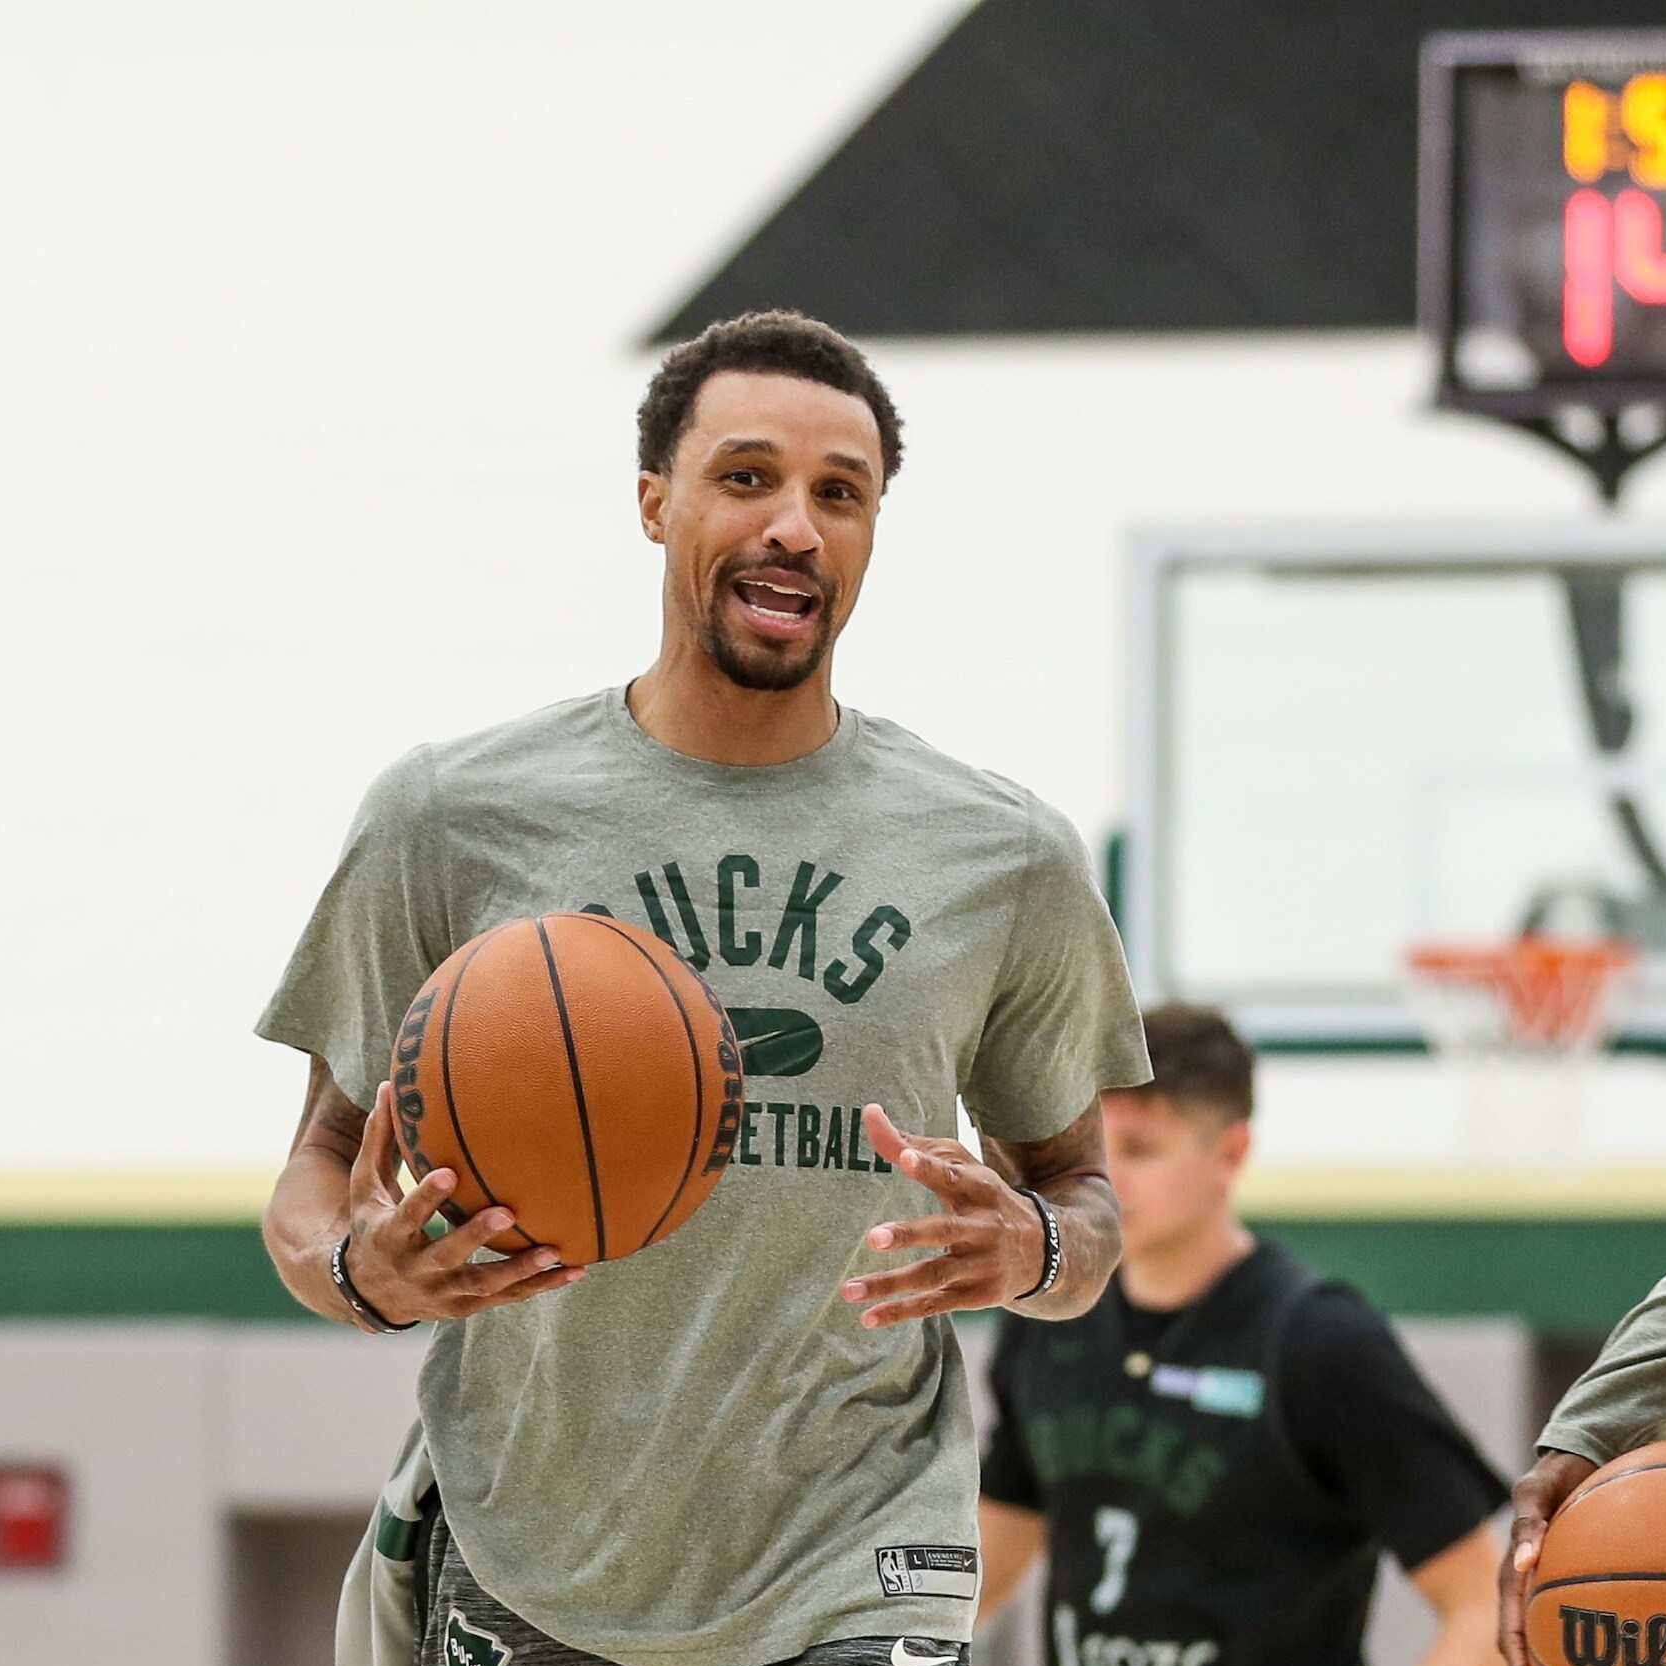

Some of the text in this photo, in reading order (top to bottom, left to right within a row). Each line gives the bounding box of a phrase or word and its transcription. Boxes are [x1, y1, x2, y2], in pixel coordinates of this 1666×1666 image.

[579, 854, 912, 1005] UCKS
[1043, 1211, 1061, 1289] Stay True
[1089, 1506, 1140, 1615] 7
